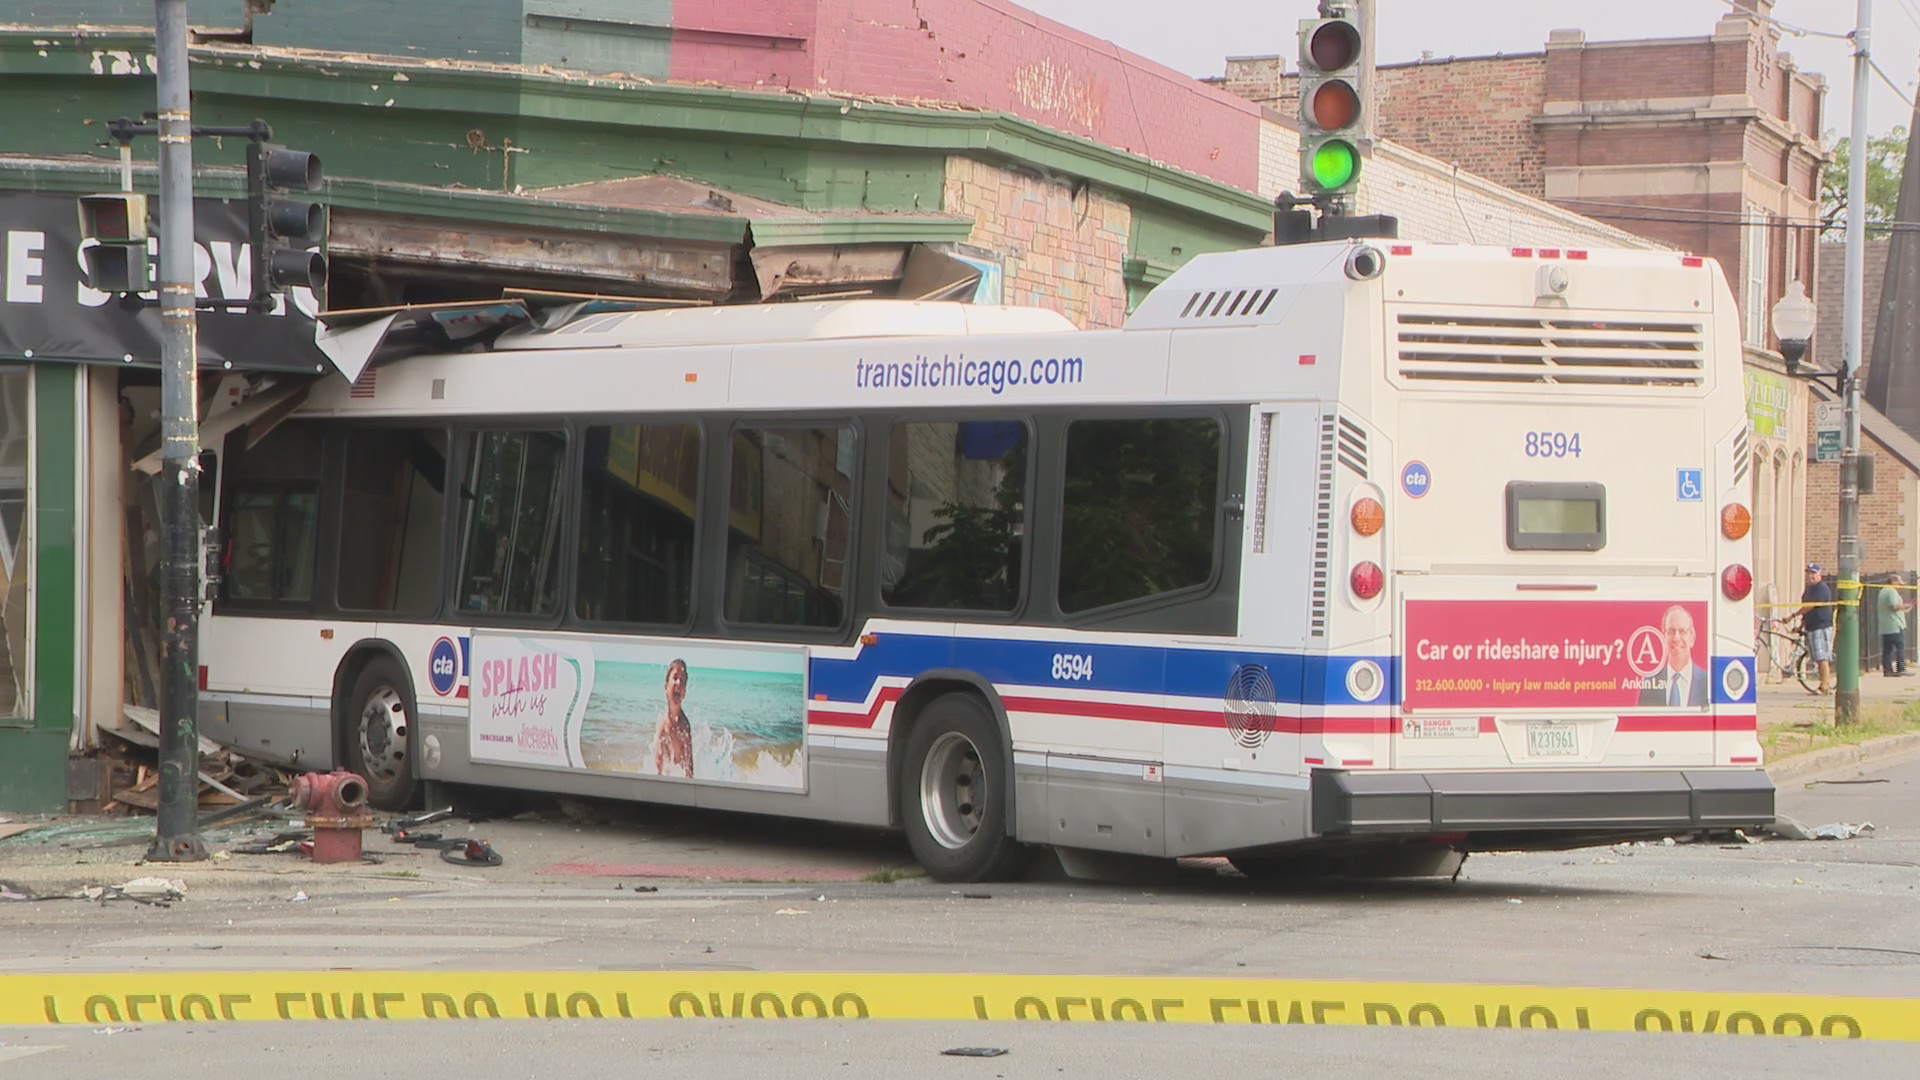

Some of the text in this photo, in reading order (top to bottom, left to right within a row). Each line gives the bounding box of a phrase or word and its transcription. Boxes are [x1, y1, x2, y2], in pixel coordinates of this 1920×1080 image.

[856, 354, 1083, 394] transitchicago.com
[1525, 431, 1581, 458] 8594
[1406, 472, 1426, 486] cta
[1417, 638, 1624, 665] Car or rideshare injury?
[433, 656, 454, 675] cta
[482, 652, 558, 698] SPLASH
[1051, 653, 1093, 681] 8594
[1415, 678, 1616, 694] 312.600.0000 Injury law made personal
[1621, 677, 1651, 690] Ankin
[492, 678, 547, 719] with us
[517, 731, 558, 750] MICHIGAN
